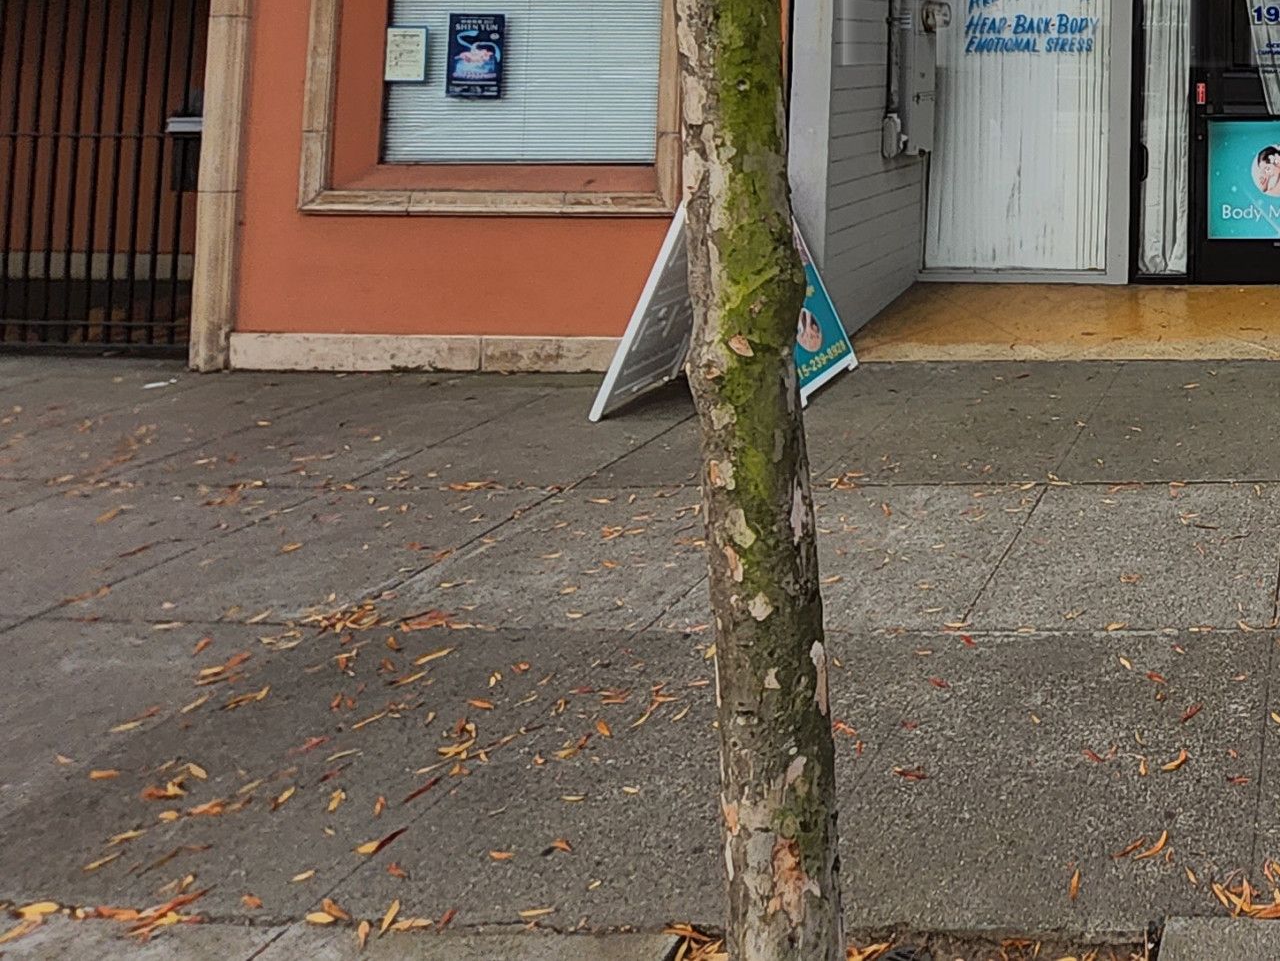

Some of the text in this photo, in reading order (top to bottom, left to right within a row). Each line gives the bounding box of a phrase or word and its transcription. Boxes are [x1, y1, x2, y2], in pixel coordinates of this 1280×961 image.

[1045, 37, 1094, 54] STRESS
[1222, 204, 1263, 222] Body
[798, 340, 847, 380] 15-239-8928
